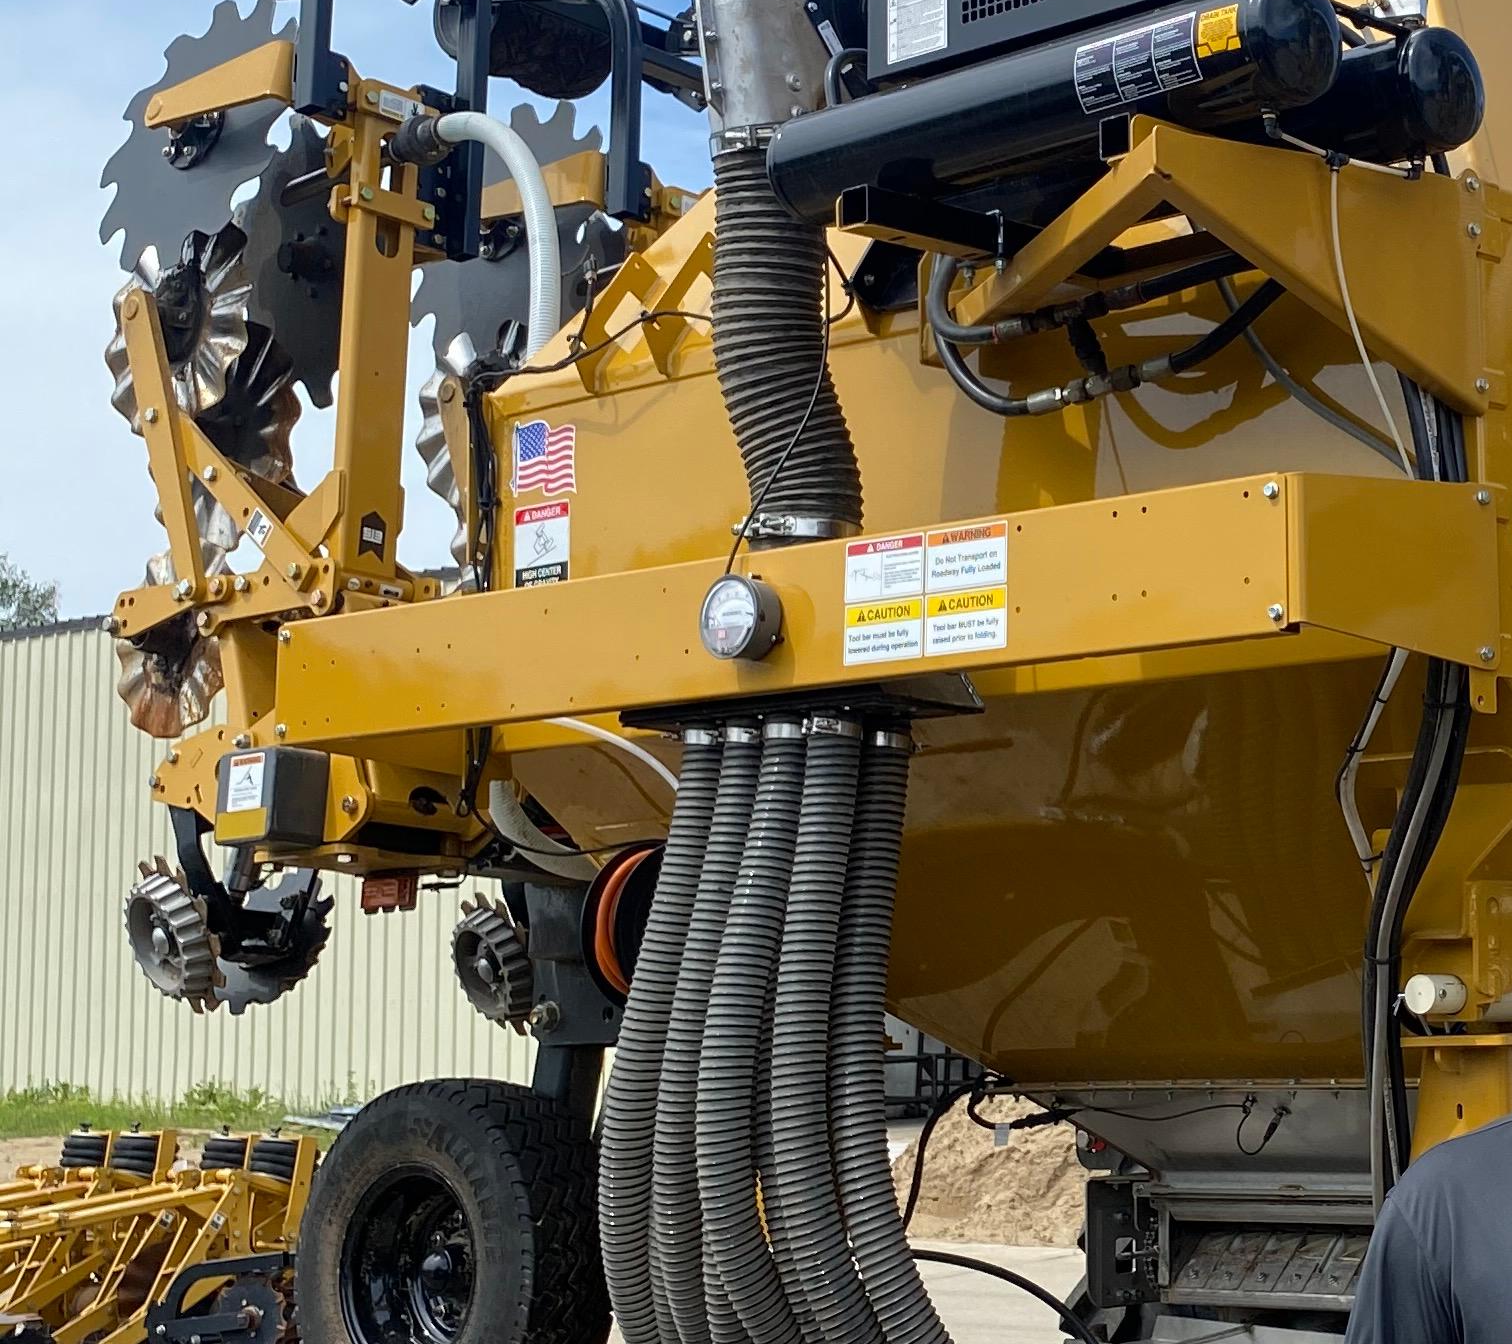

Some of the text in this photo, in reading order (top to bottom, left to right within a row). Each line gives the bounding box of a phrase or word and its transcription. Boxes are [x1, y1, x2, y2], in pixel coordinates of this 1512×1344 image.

[531, 506, 561, 520] DANGER
[950, 527, 991, 543] WARNING
[876, 540, 904, 552] DANGER
[935, 557, 944, 565] Do
[945, 555, 957, 564] Not
[958, 550, 988, 562] Transport
[537, 565, 562, 578] CENTER
[931, 561, 1001, 579] Roadway Fully Loaded
[949, 594, 994, 610] CAUTION
[867, 605, 911, 621] CAUTION
[932, 623, 946, 632] Tool
[946, 623, 957, 631] bar
[958, 619, 976, 629] MUST
[976, 619, 985, 627] be
[848, 633, 861, 642] Tool
